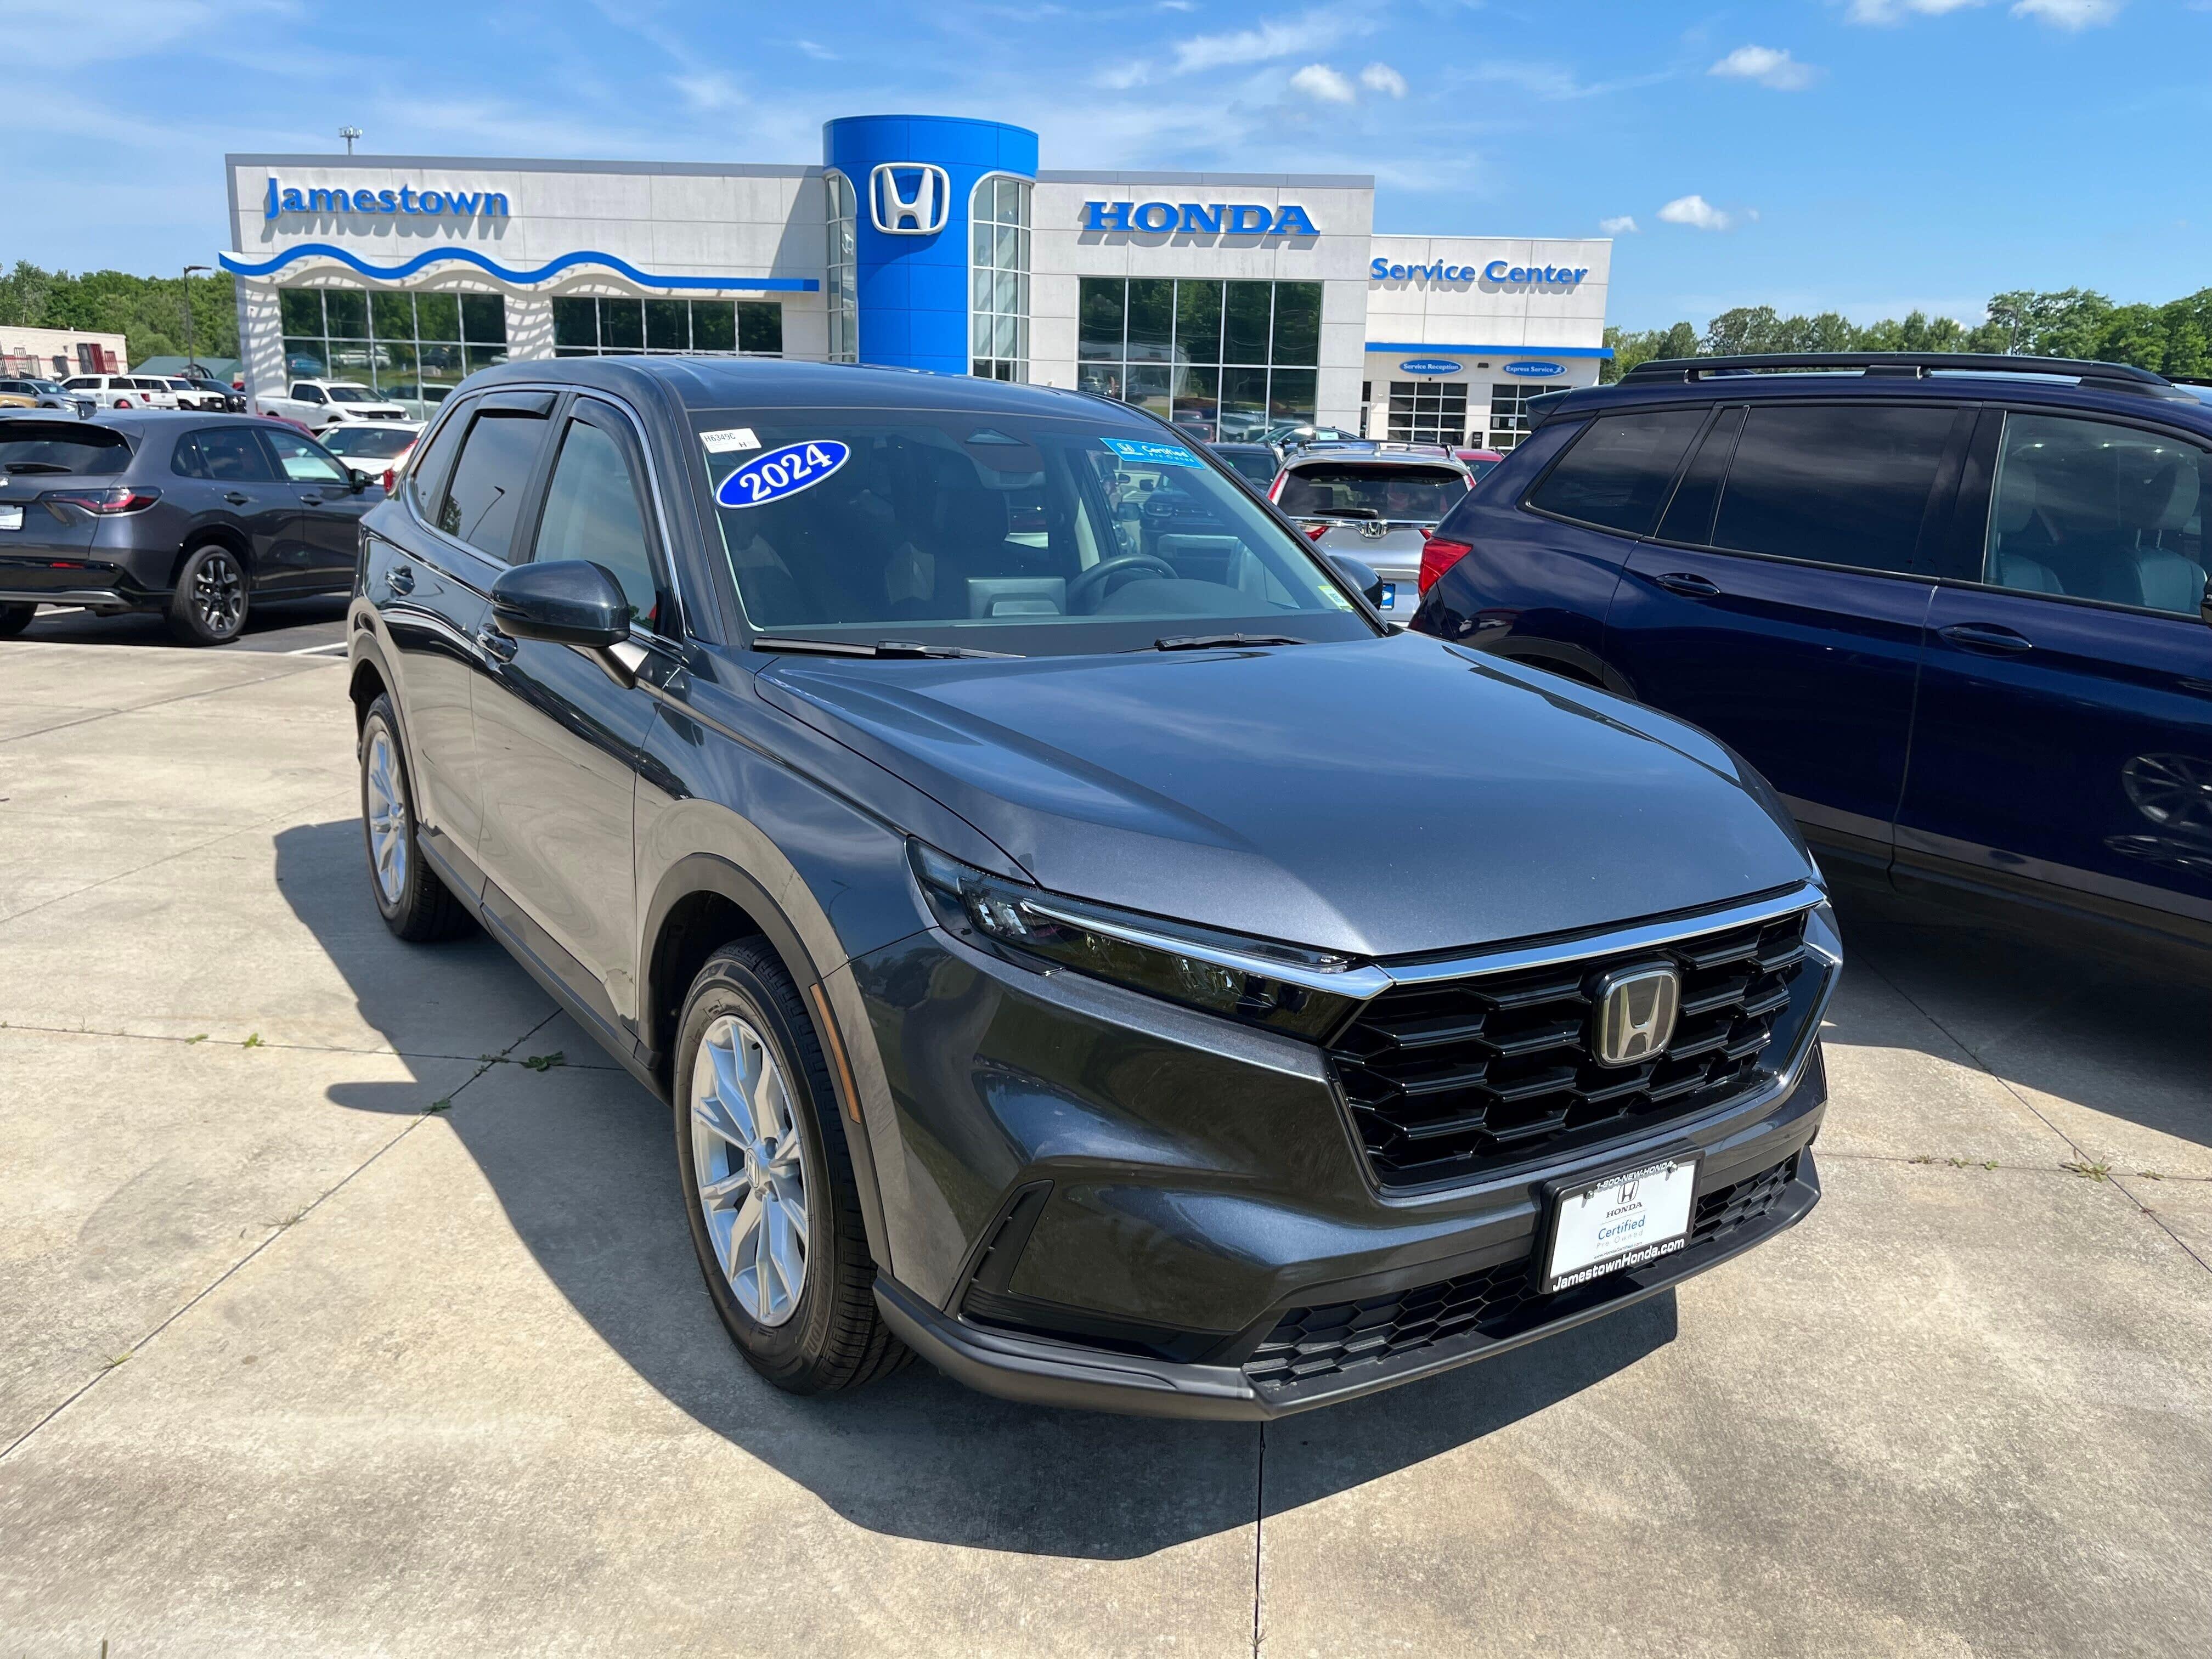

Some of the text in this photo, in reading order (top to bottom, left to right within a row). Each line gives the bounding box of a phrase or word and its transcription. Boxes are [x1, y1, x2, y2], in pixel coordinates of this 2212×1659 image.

[266, 177, 509, 220] Jamestown
[1084, 201, 1320, 235] HONDA
[1372, 258, 1588, 284] Service Center
[703, 433, 736, 442] H6349C
[740, 444, 833, 501] 2024
[1606, 1201, 1643, 1218] HONDA
[1598, 1215, 1645, 1240] Certified
[1553, 1238, 1685, 1291] JamestownHonda.com
